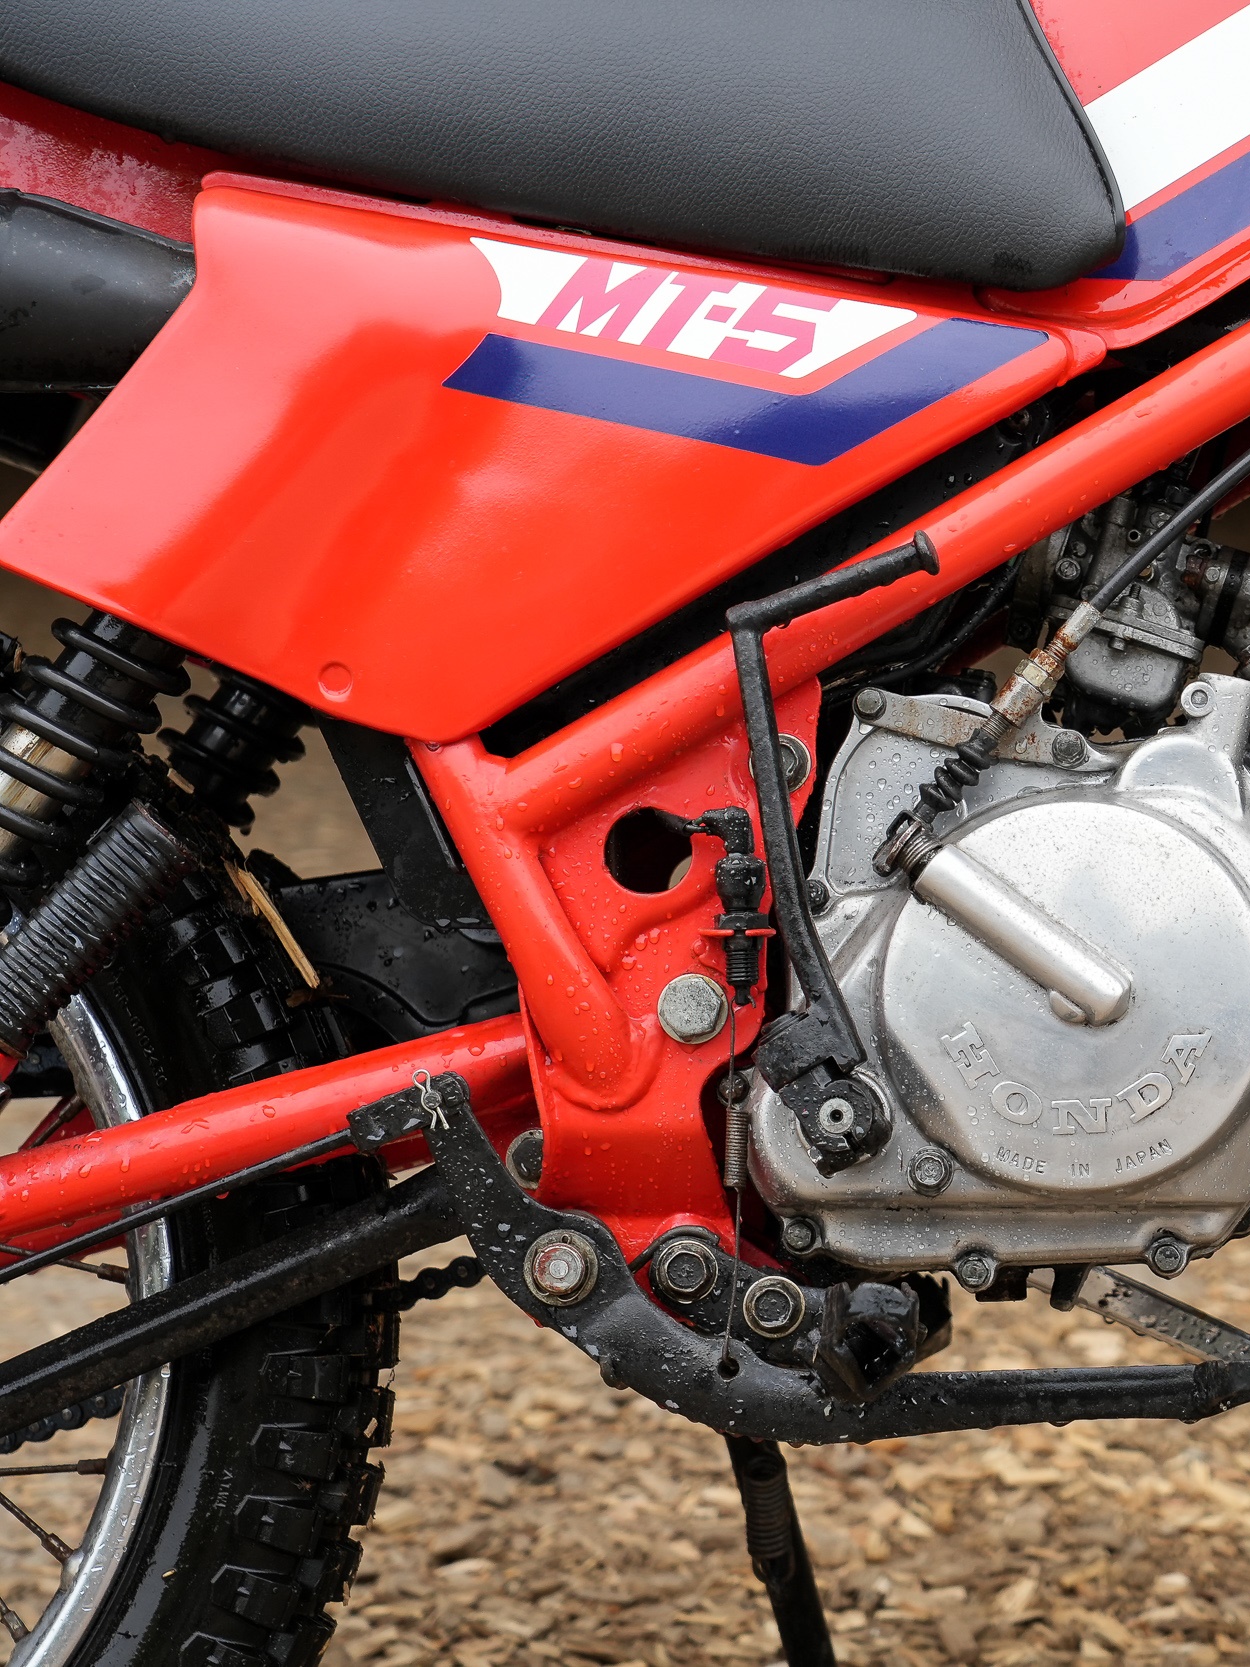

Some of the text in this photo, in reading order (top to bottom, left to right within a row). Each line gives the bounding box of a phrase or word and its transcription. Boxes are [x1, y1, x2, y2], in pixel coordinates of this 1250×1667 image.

[535, 257, 841, 375] MT-5
[940, 1021, 1213, 1136] HONDA
[995, 1138, 1174, 1178] MADE IN JAPAN
